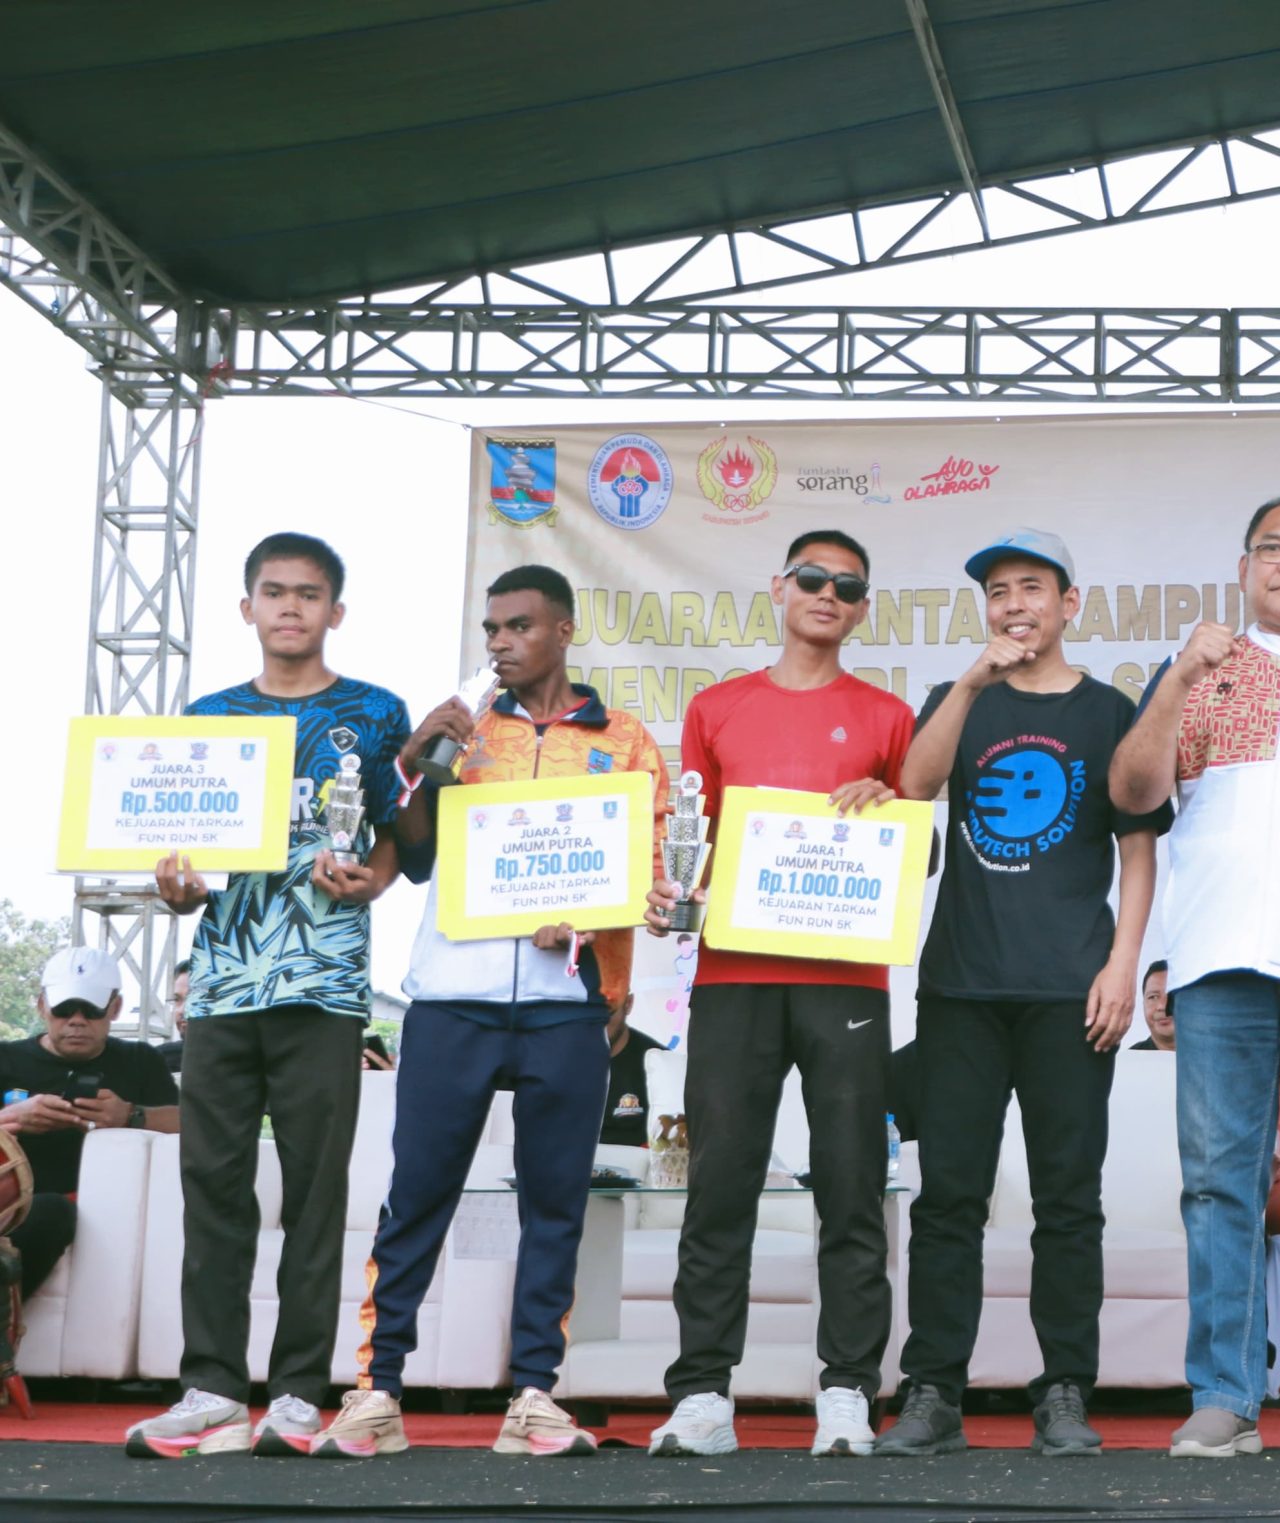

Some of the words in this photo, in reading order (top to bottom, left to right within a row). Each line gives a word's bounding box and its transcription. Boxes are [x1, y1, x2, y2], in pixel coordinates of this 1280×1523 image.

[797, 474, 869, 496] serang
[572, 588, 785, 647] JUARAA
[976, 739, 1015, 768] ALUMNI
[1017, 734, 1068, 753] TRAINING
[151, 764, 193, 775] JUARA
[196, 764, 205, 775] 3
[130, 777, 176, 788] UMUM
[180, 777, 227, 788] PUTRA
[120, 791, 239, 816] Rp.500.000
[116, 818, 185, 828] KEJUARAN
[189, 818, 244, 828] TARKAM
[138, 832, 165, 842] FUN
[170, 832, 199, 842] RUN
[202, 832, 219, 842] 5K
[520, 826, 561, 839] JUARA
[564, 826, 572, 836] 2
[502, 840, 545, 854] UMUM
[549, 838, 593, 850] PUTRA
[796, 843, 835, 856] JUARA
[838, 847, 844, 857] 1
[495, 850, 605, 881] Rp.750.000
[775, 855, 818, 870] UMUM
[821, 859, 865, 874] PUTRA
[490, 880, 556, 894] KEJUARAN
[559, 876, 611, 889] TARKAM
[757, 868, 882, 901] Rp.1.000.000
[512, 897, 538, 908] FUN
[542, 895, 570, 906] RUN
[572, 893, 588, 903] 5K
[758, 897, 822, 912] KEJUARAN
[827, 901, 877, 916] TARKAM
[778, 915, 804, 926] FUN
[807, 916, 834, 928] RUN
[837, 919, 852, 930] 5K
